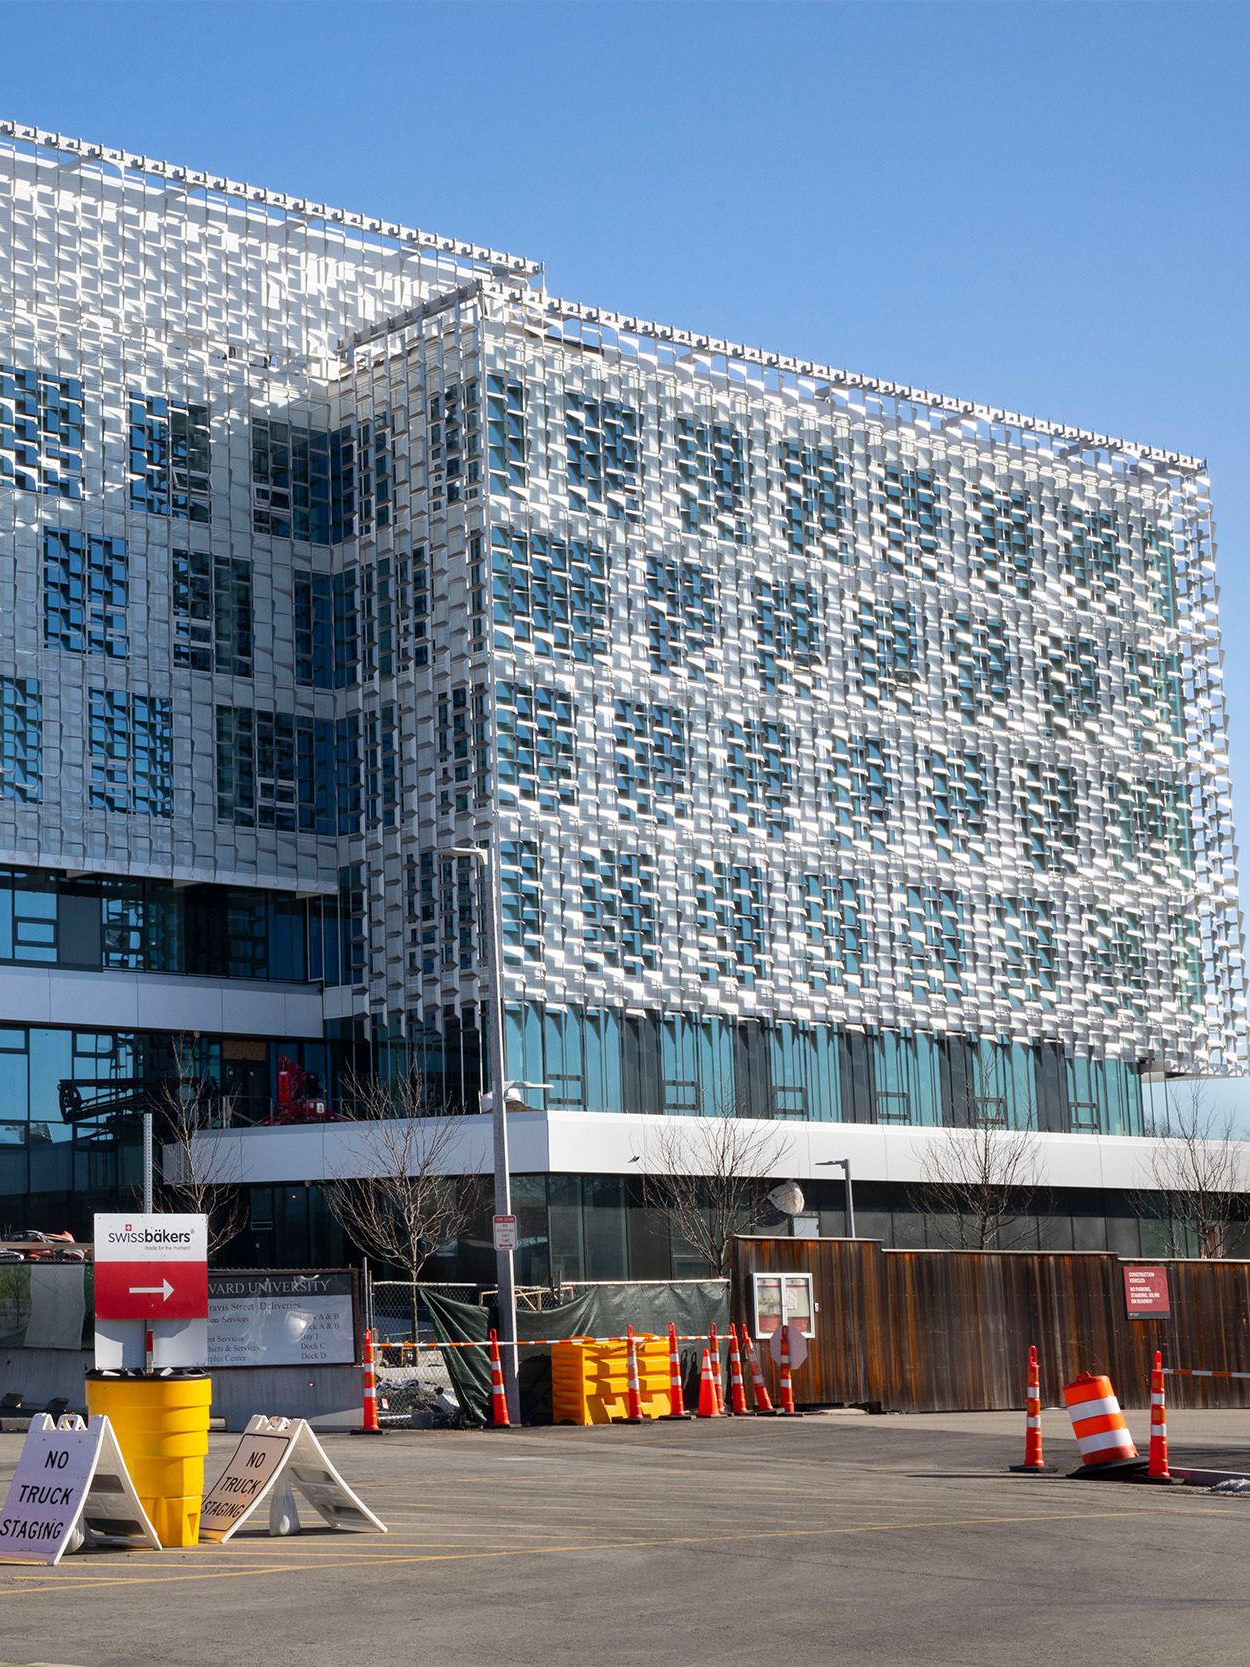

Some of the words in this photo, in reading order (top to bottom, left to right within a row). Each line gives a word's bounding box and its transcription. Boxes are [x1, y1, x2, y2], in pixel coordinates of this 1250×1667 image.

[248, 1280, 330, 1294] UNIVERSITY
[208, 1303, 229, 1312] ravis
[231, 1302, 254, 1311] Street
[260, 1301, 301, 1311] Deliveries
[222, 1315, 249, 1323] Services
[333, 1312, 339, 1320] B
[217, 1335, 245, 1343] Services
[233, 1344, 261, 1352] Services
[300, 1342, 319, 1350] Dock
[319, 1342, 326, 1350] C
[225, 1354, 246, 1362] Center
[301, 1352, 319, 1360] Dock
[44, 1450, 69, 1469] NO
[246, 1452, 266, 1468] NO
[220, 1476, 262, 1496] TRUCK
[19, 1484, 74, 1506] TRUCK
[201, 1500, 244, 1519] STAGING
[0, 1519, 64, 1541] STAGING
